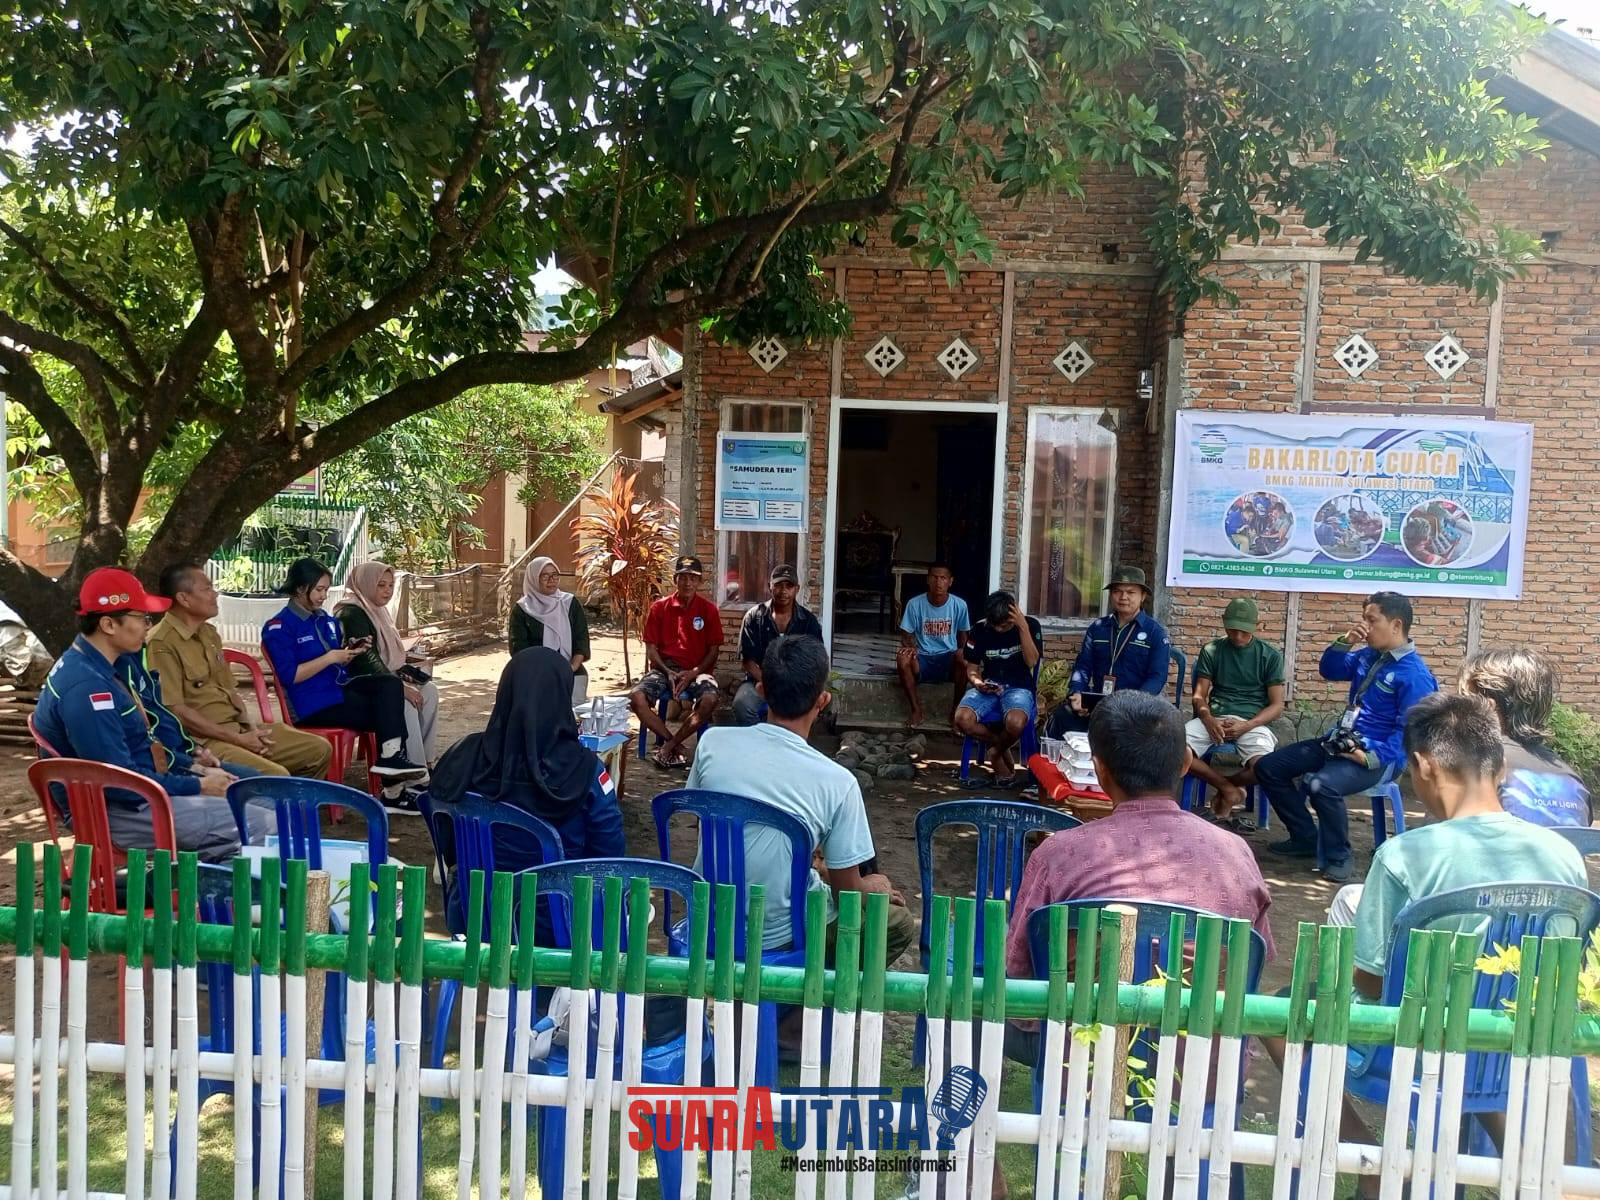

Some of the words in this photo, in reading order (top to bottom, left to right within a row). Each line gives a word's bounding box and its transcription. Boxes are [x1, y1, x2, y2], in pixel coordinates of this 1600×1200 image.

[1248, 447, 1375, 473] BAKARLOTA
[1386, 451, 1458, 475] CUACA
[1265, 475, 1294, 486] BMKG
[1298, 476, 1345, 487] MARITIM
[1348, 478, 1398, 488] SULAWESI
[1401, 480, 1434, 490] UTARA
[1274, 566, 1294, 574] BMKG
